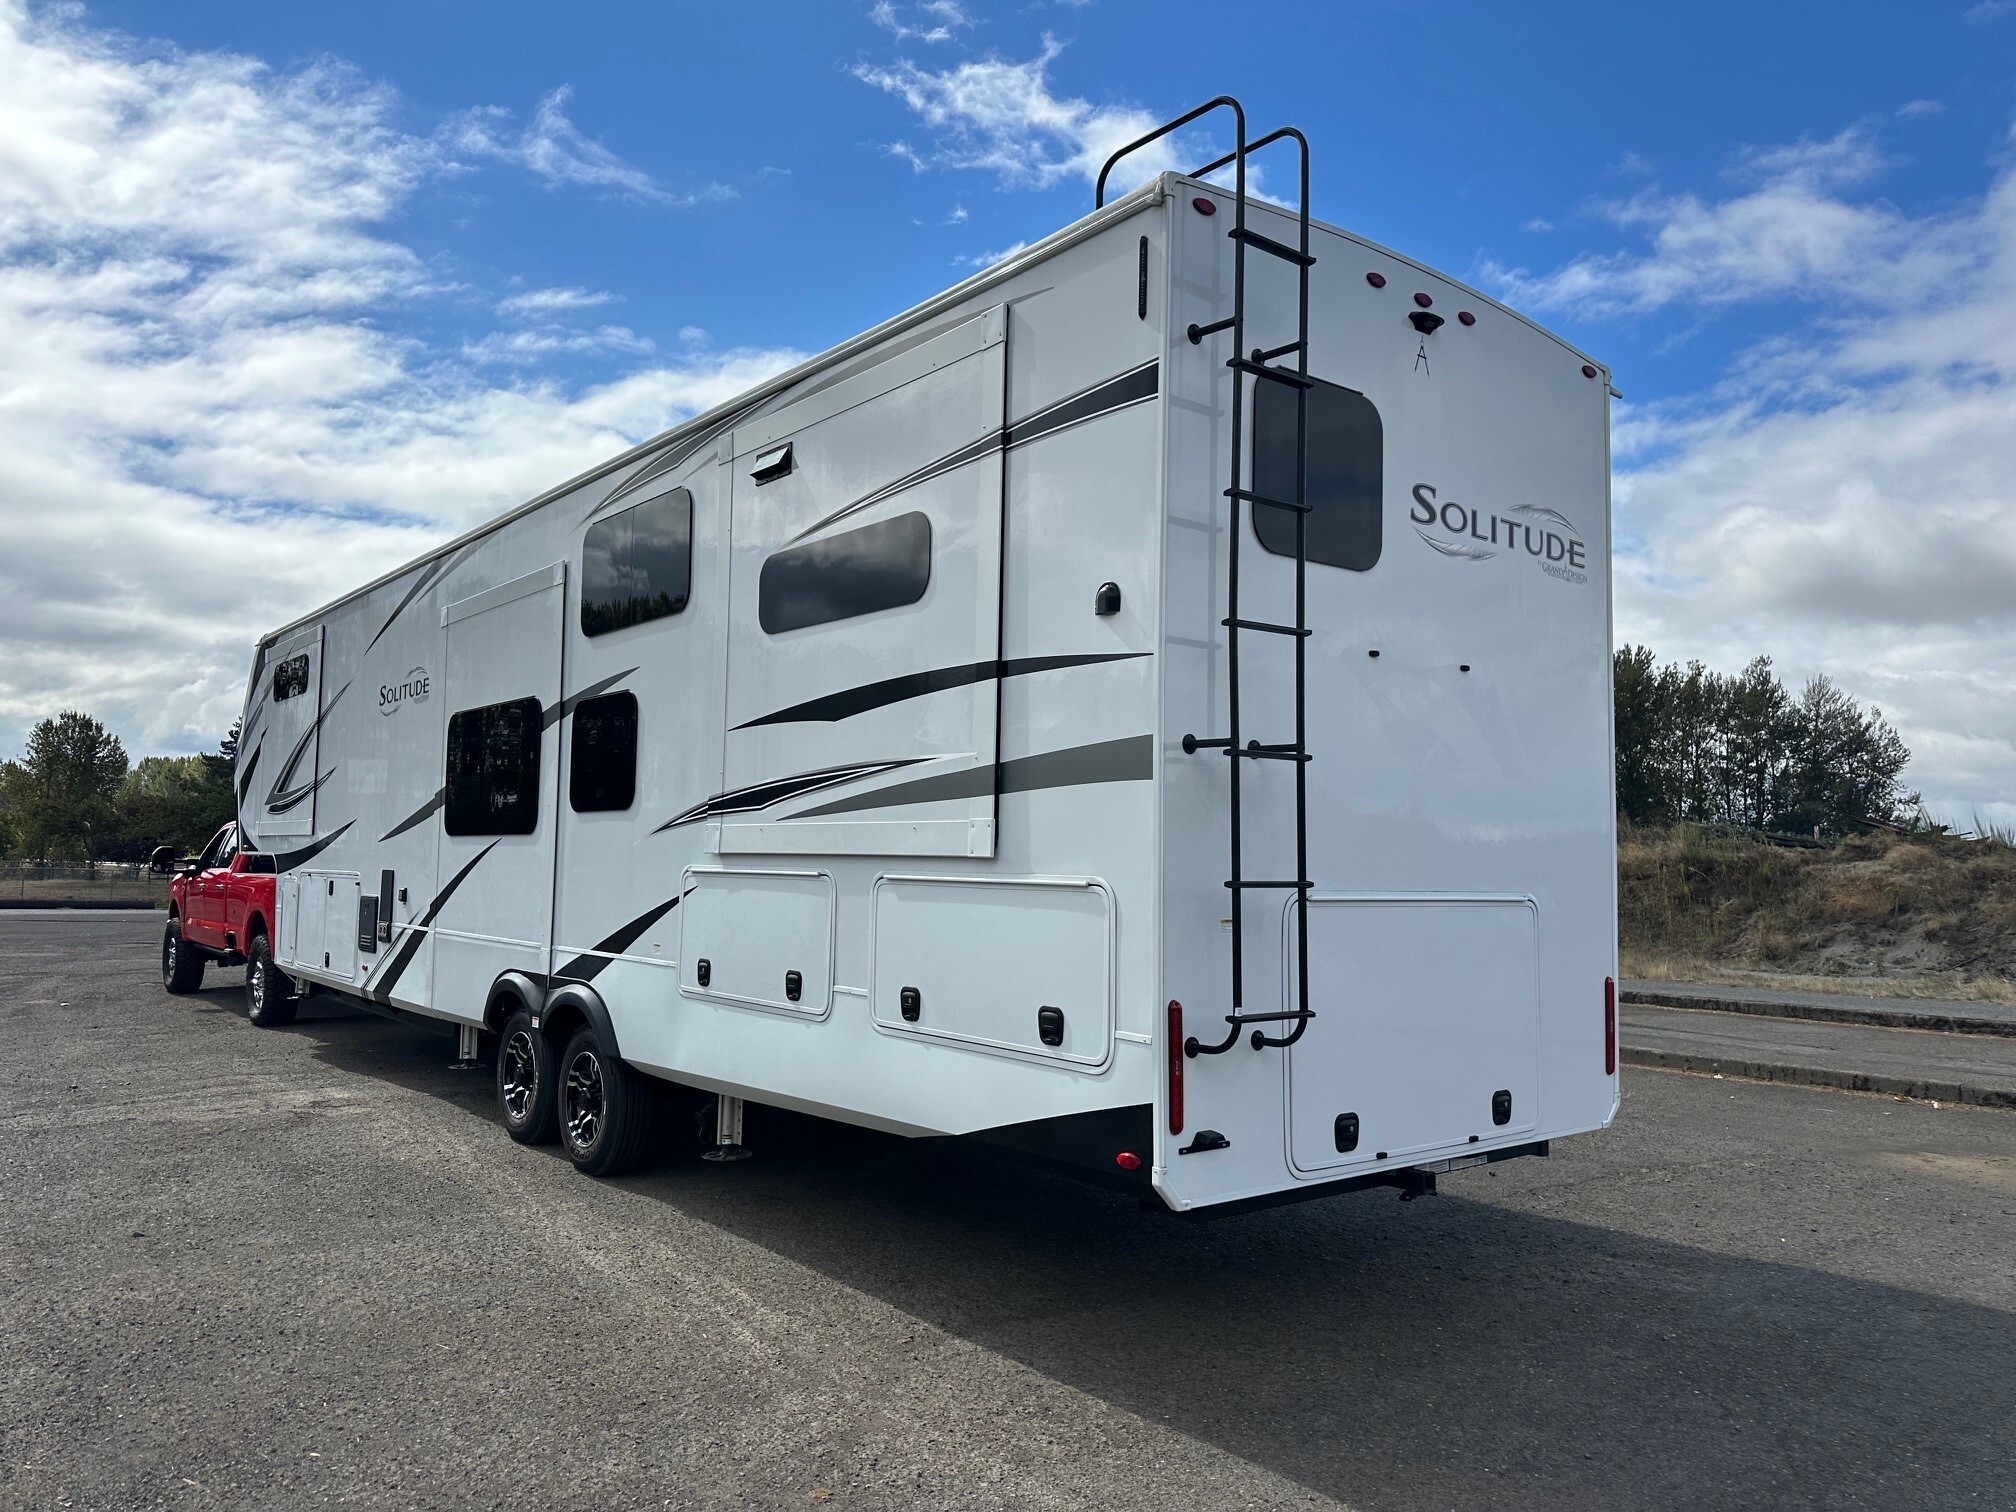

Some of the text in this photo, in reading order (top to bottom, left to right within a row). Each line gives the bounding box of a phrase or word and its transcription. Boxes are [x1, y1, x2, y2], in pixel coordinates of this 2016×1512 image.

[1410, 482, 1586, 569] SOLITUDE
[1542, 561, 1563, 576] GRAND
[1568, 569, 1588, 582] DESIGN
[379, 678, 429, 706] SOLITUDE
